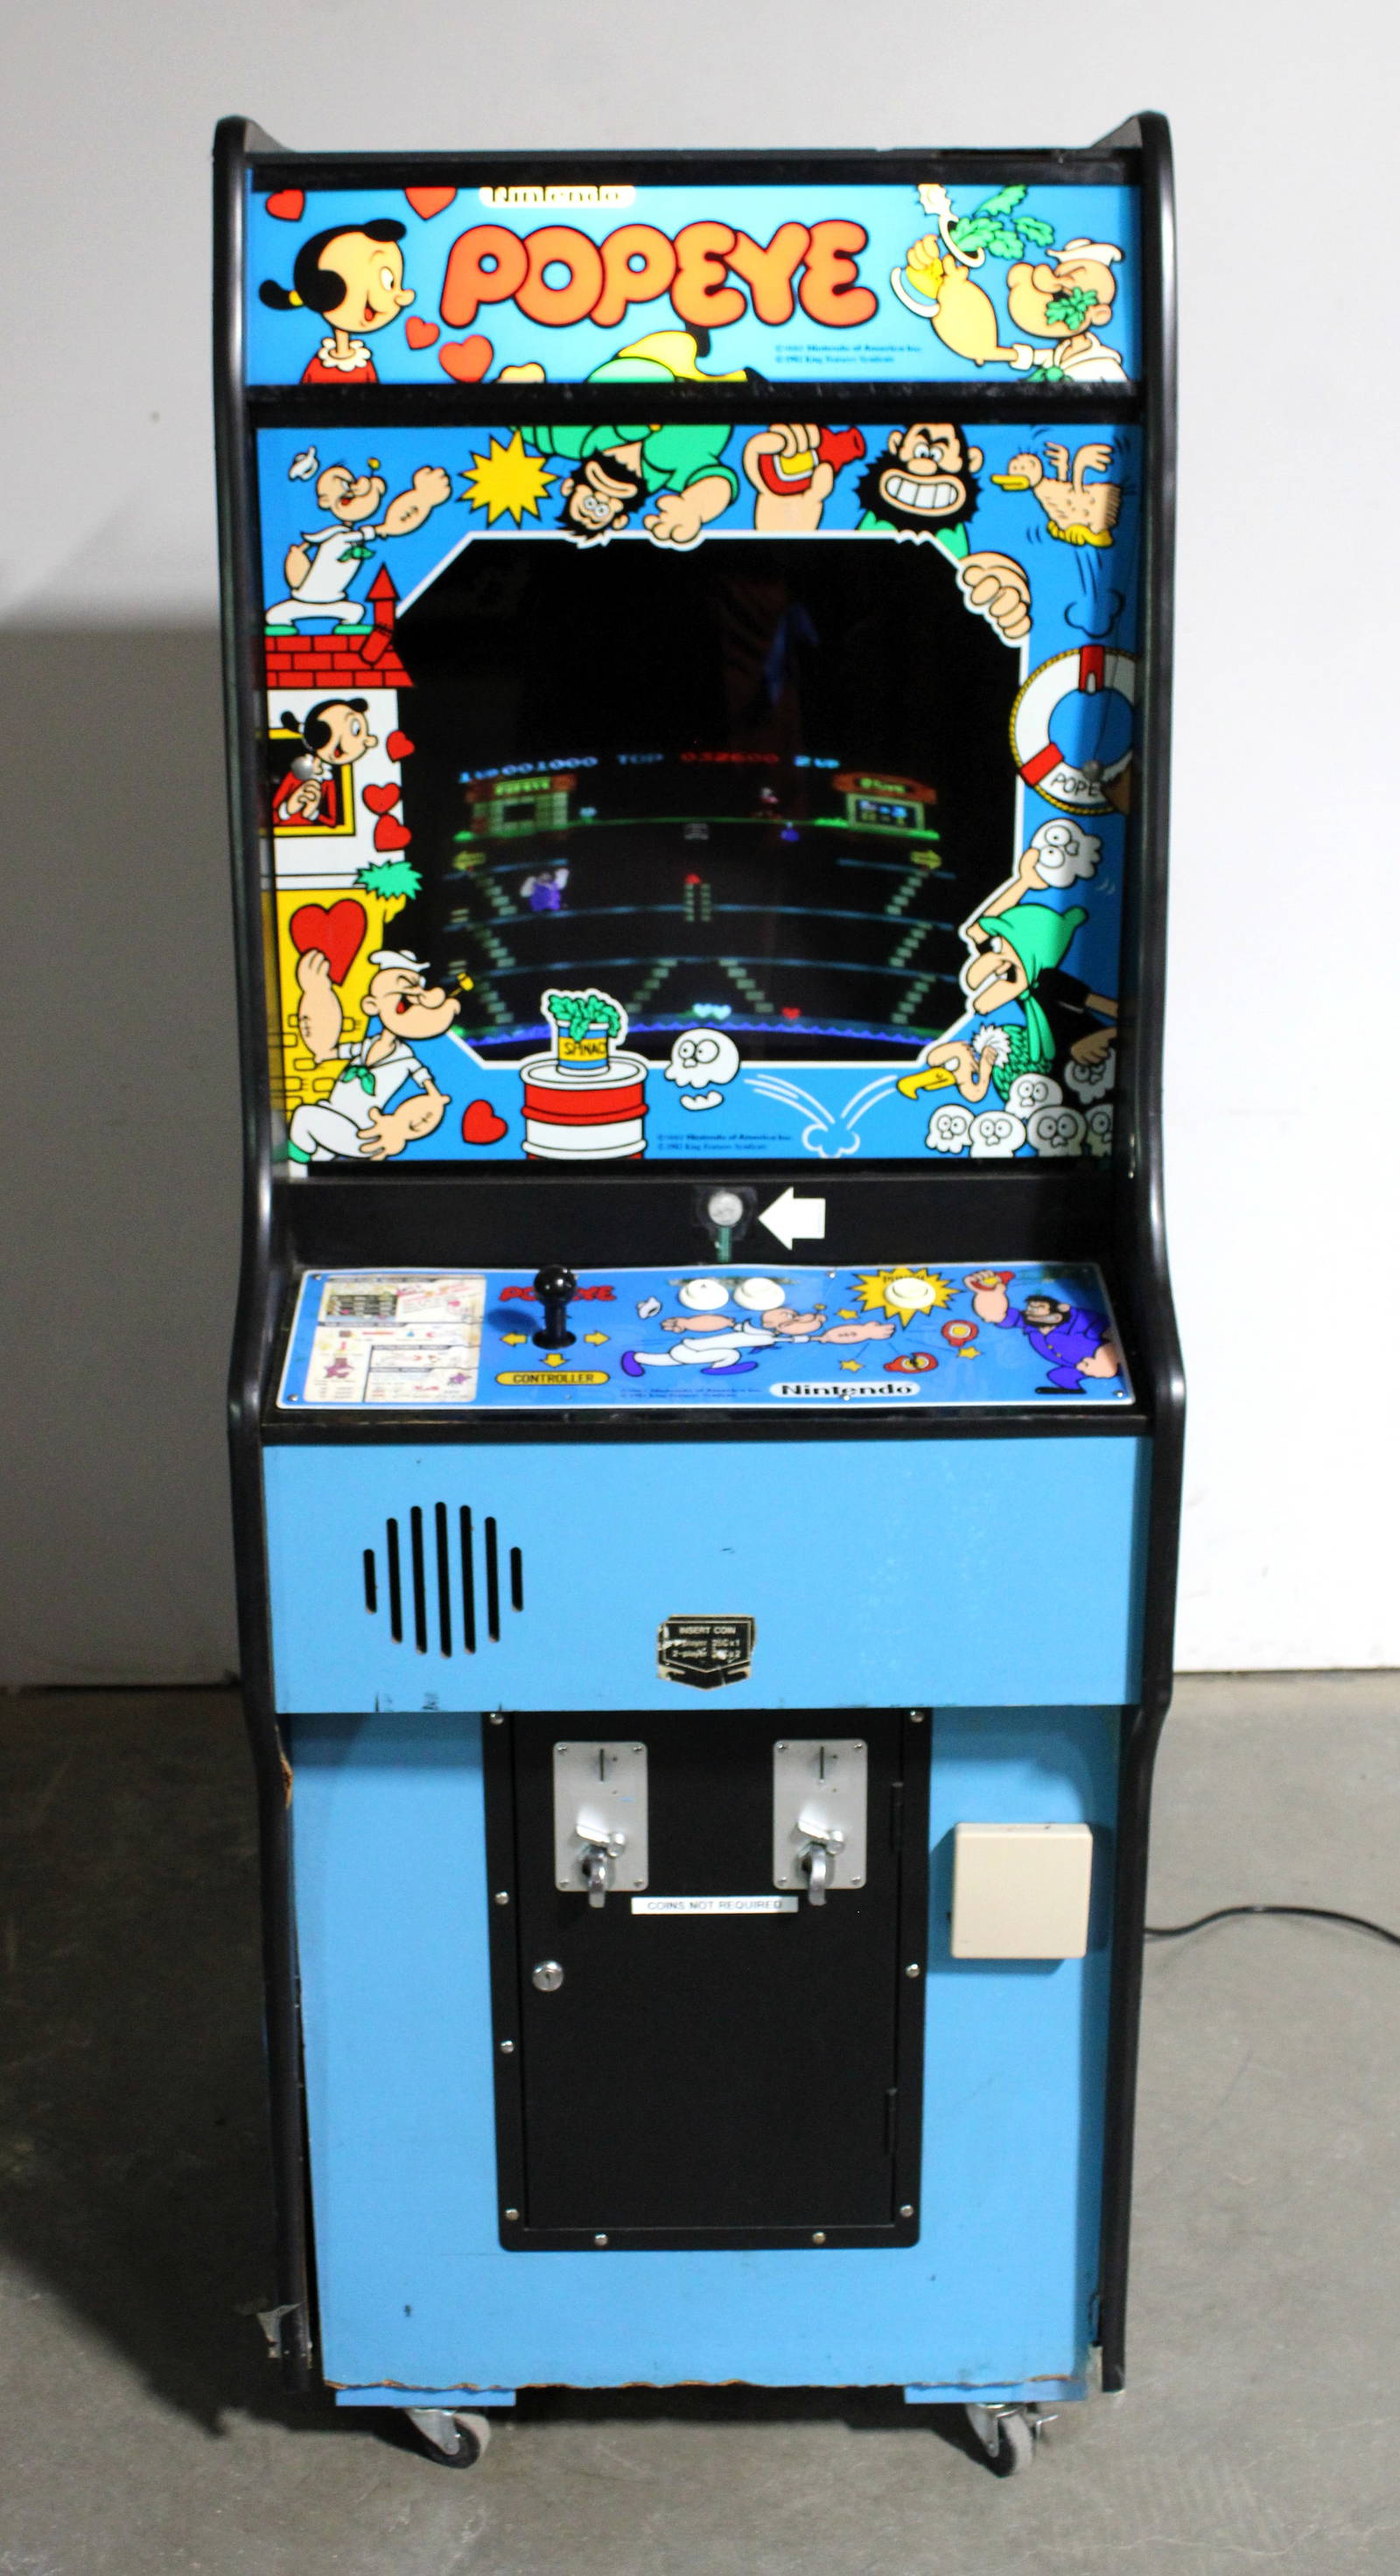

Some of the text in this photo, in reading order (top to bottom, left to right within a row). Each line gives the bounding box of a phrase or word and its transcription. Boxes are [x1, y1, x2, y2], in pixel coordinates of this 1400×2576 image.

[440, 219, 879, 329] POPEYE
[499, 1285, 617, 1302] POYE
[513, 1373, 594, 1384] CONTROLLER
[781, 1384, 913, 1396] Nintendo
[648, 1900, 783, 1910] COINS NOT REQUIRED
